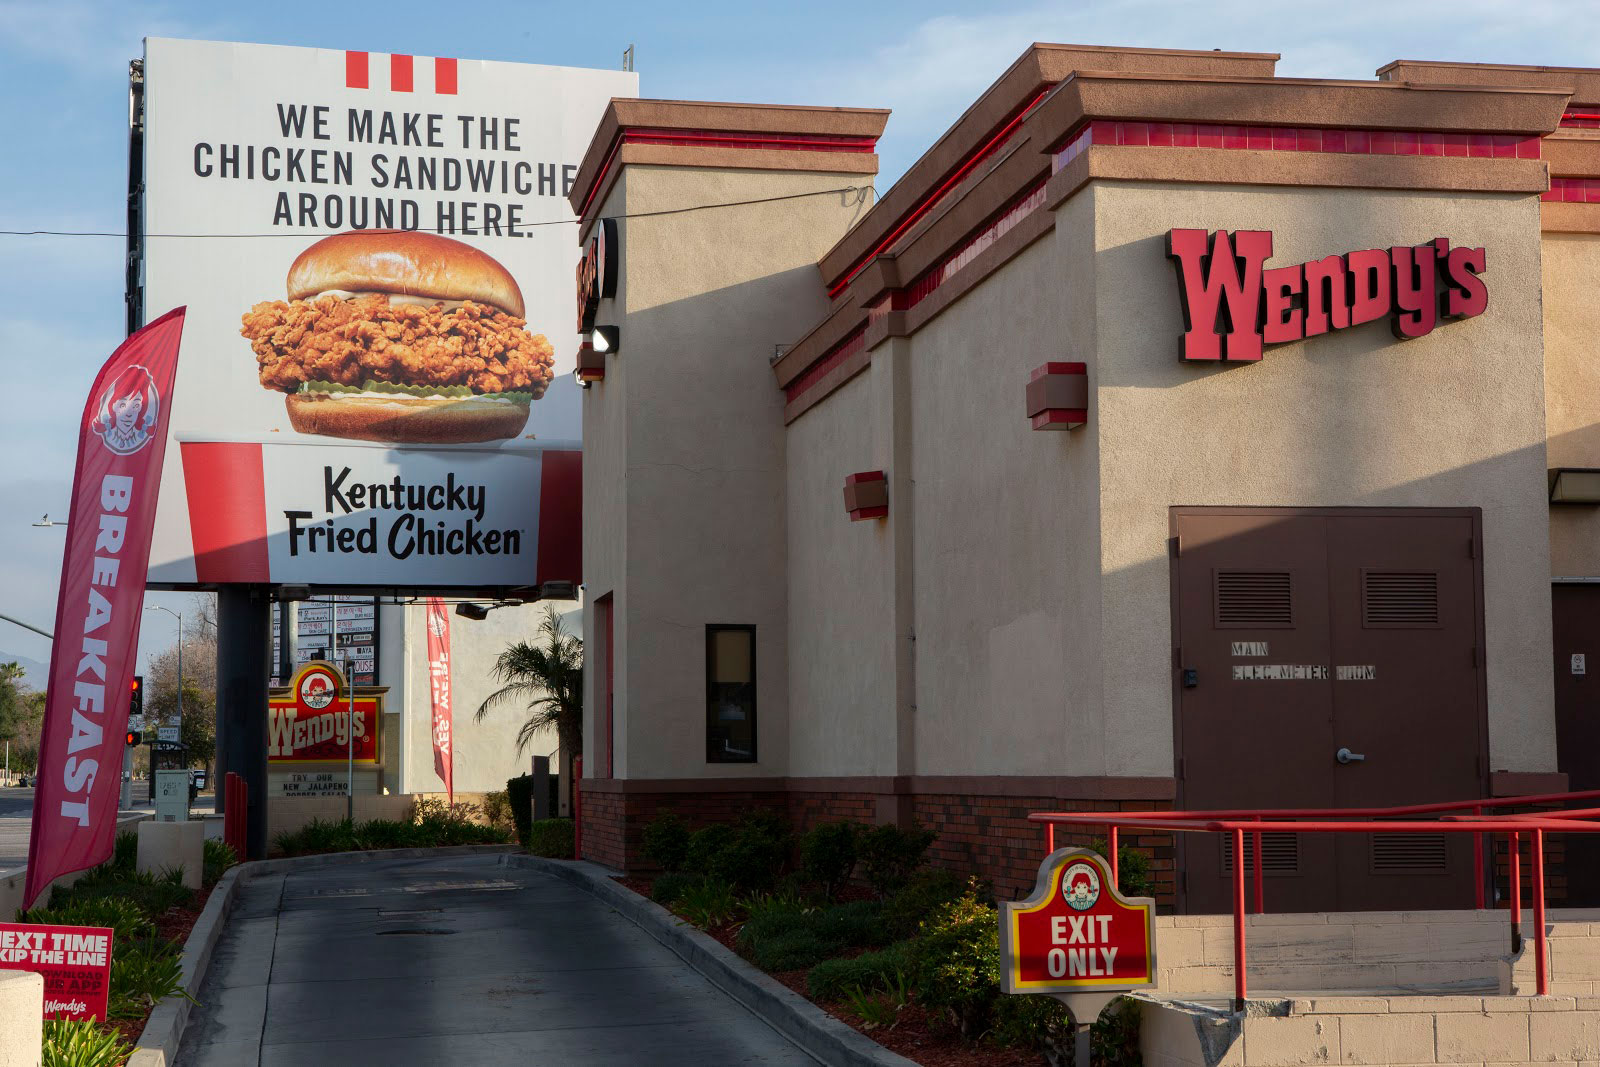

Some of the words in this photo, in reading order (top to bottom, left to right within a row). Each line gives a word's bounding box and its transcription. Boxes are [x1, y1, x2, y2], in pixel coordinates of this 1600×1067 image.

[276, 103, 331, 140] WE
[348, 108, 444, 148] MAKE
[457, 115, 521, 151] THE
[194, 142, 353, 185] CHICKEN
[371, 153, 577, 197] SANDWICHE
[273, 191, 419, 231] AROUND
[437, 200, 534, 238] HERE.
[324, 466, 486, 522] Kentucky
[284, 511, 377, 556] Fried
[388, 513, 520, 560] Chicken
[342, 635, 352, 645] TJ
[1231, 642, 1268, 656] MAIN
[60, 474, 134, 827] BREAKFAST
[354, 661, 373, 672] OUSE
[283, 783, 300, 791] NEW
[308, 782, 348, 791] JALAPENO
[292, 774, 308, 782] TRY
[316, 774, 333, 782] OUR
[1051, 915, 1113, 944] EXIT
[51, 933, 108, 952] TIME
[0, 948, 28, 962] KIP
[30, 950, 65, 964] THE
[67, 951, 107, 966] LINE
[1047, 947, 1119, 978] ONLY
[34, 970, 103, 979] OWNLOAD
[69, 980, 102, 990] APP
[45, 998, 86, 1015] Wendy's
